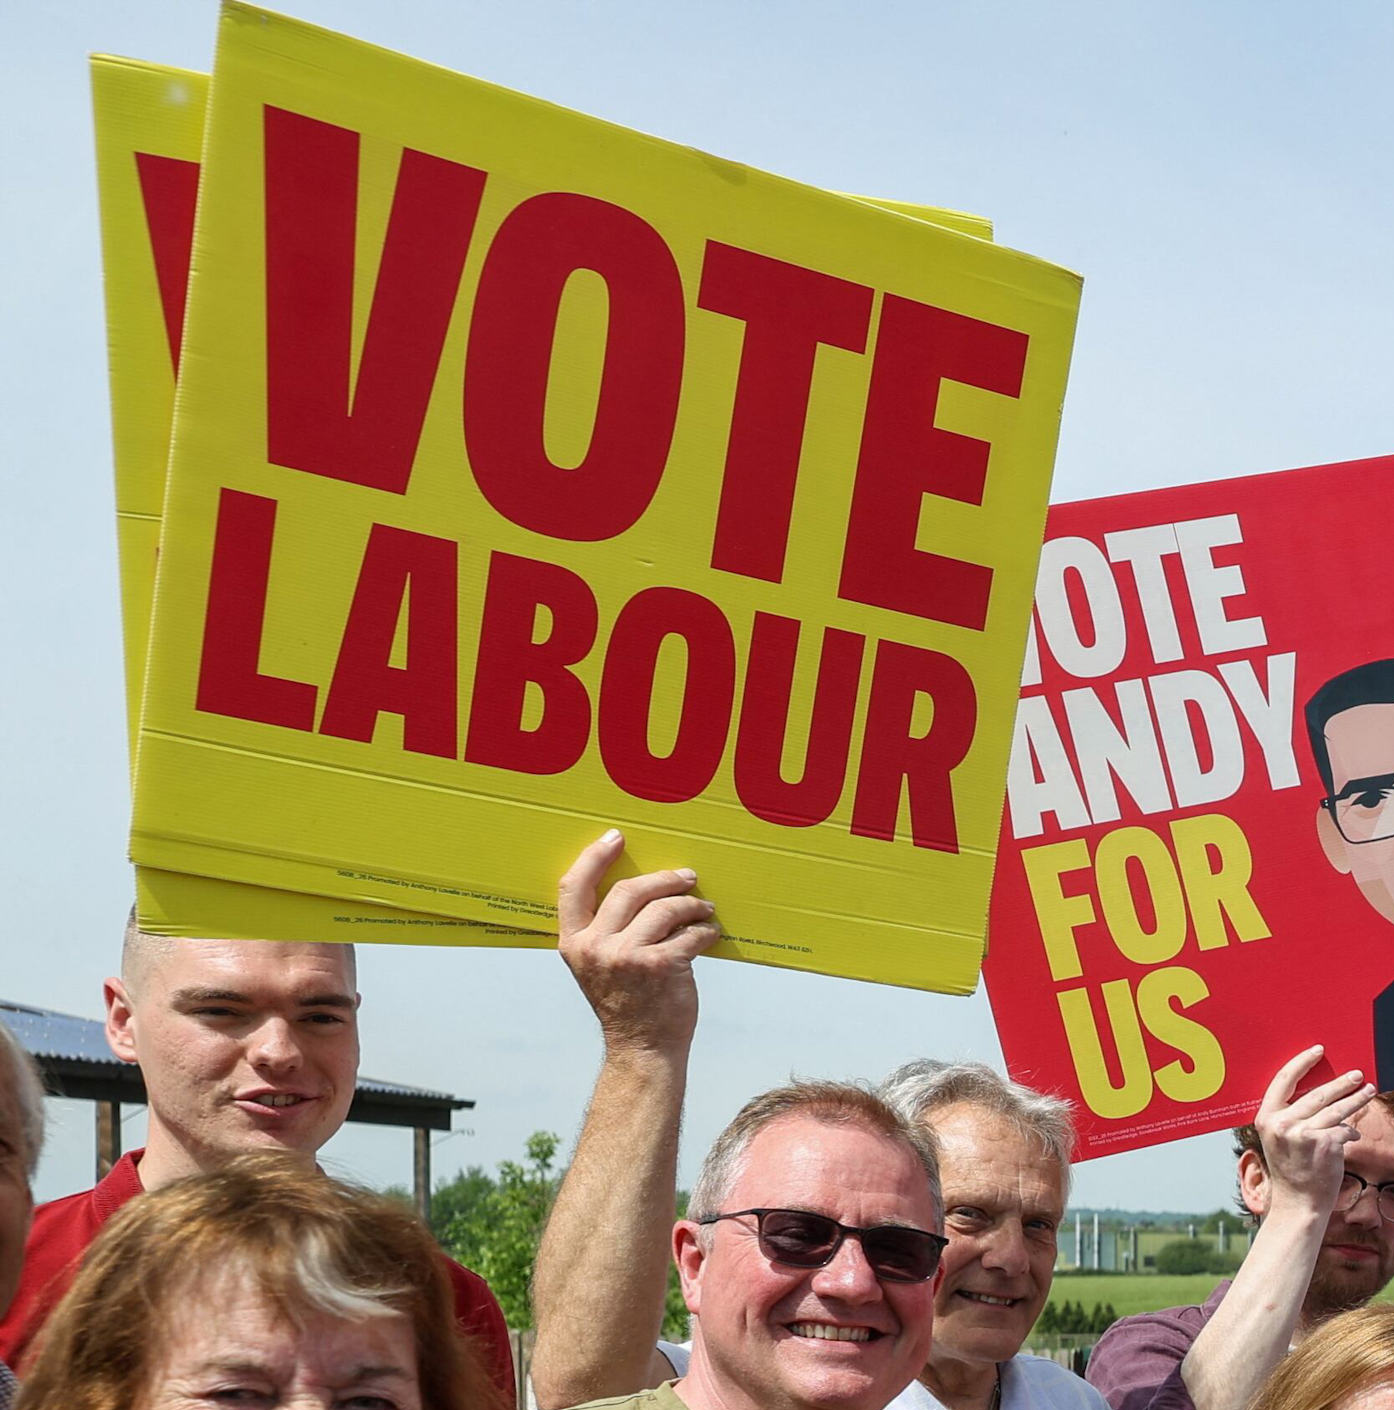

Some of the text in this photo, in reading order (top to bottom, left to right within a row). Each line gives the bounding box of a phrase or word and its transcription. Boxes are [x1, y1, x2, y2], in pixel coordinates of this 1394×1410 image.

[263, 104, 1029, 632] VOTE
[195, 487, 977, 854] LABOUR
[1021, 514, 1268, 686] OTE
[1013, 652, 1300, 839] ANDY
[1021, 814, 1272, 981] FOR
[1056, 966, 1225, 1120] US
